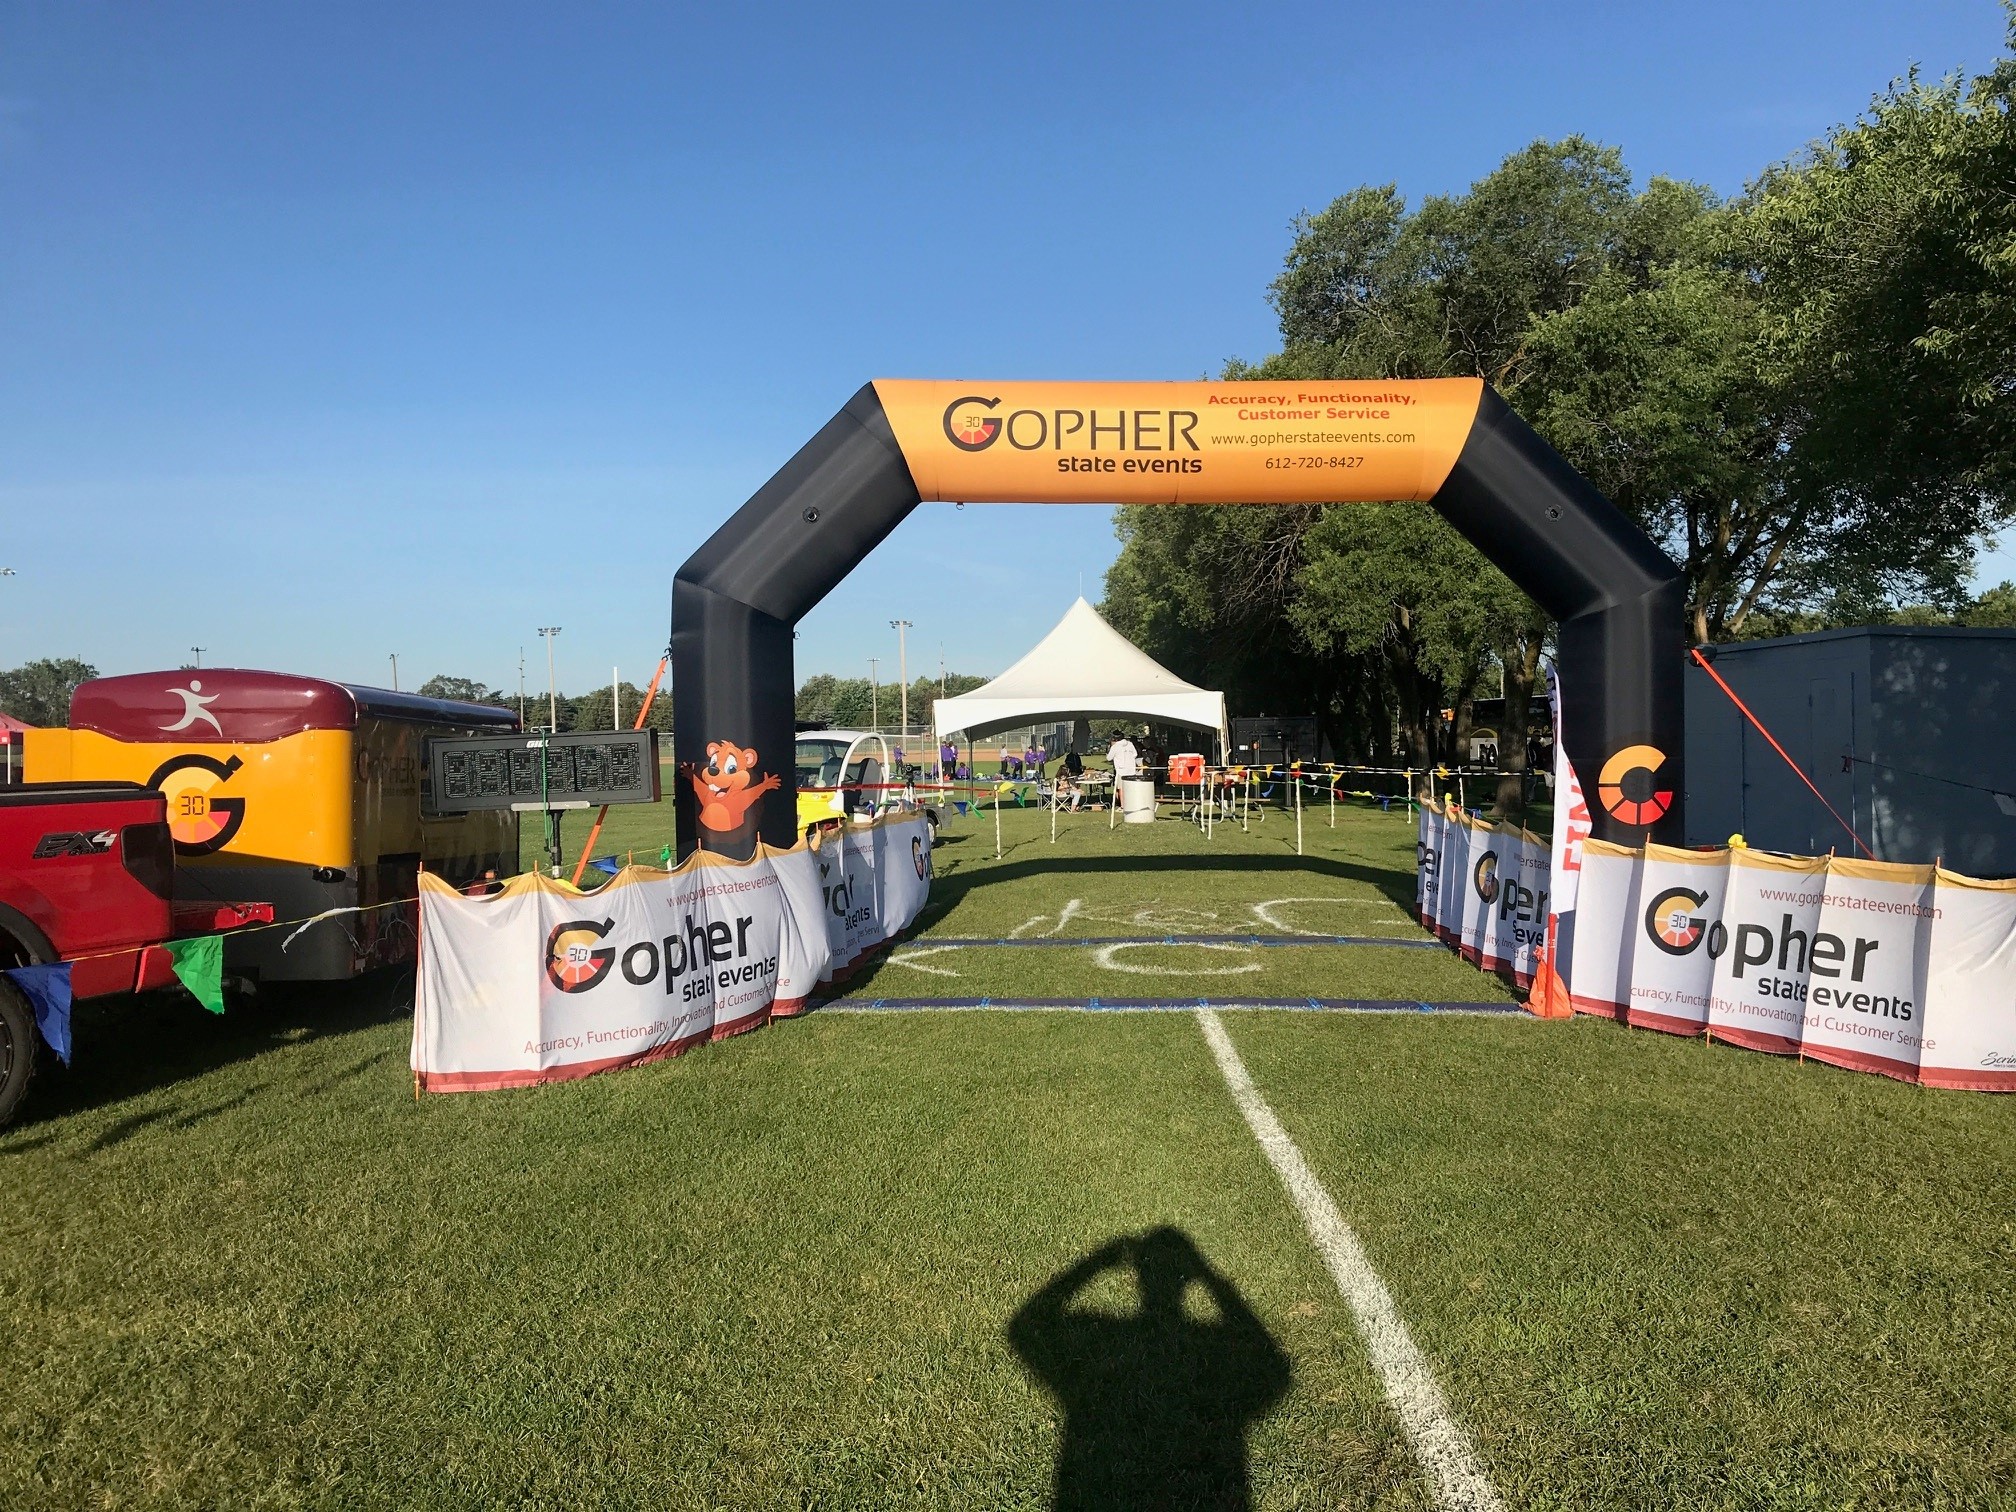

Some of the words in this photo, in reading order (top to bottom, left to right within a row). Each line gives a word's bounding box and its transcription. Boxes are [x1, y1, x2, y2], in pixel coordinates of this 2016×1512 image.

[1208, 395, 1292, 406] Accuracy,
[1297, 393, 1417, 405] Functionality,
[943, 396, 1201, 452] GOPHER
[1237, 409, 1321, 421] Customer
[1326, 407, 1391, 420] Service
[1211, 432, 1416, 447] www.gopherstateevents.com
[1057, 456, 1117, 473] state
[1123, 457, 1203, 474] events
[1265, 456, 1364, 469] 612-720-8427
[181, 796, 204, 815] 30
[1645, 887, 1880, 983] Gopher
[546, 916, 753, 994] Gopher
[718, 955, 776, 989] events
[1758, 977, 1808, 1002] state
[1812, 987, 1913, 1022] events
[524, 1036, 584, 1054] Accuracy,
[587, 1019, 671, 1044] Functionality,
[1824, 1017, 1894, 1042] Customer
